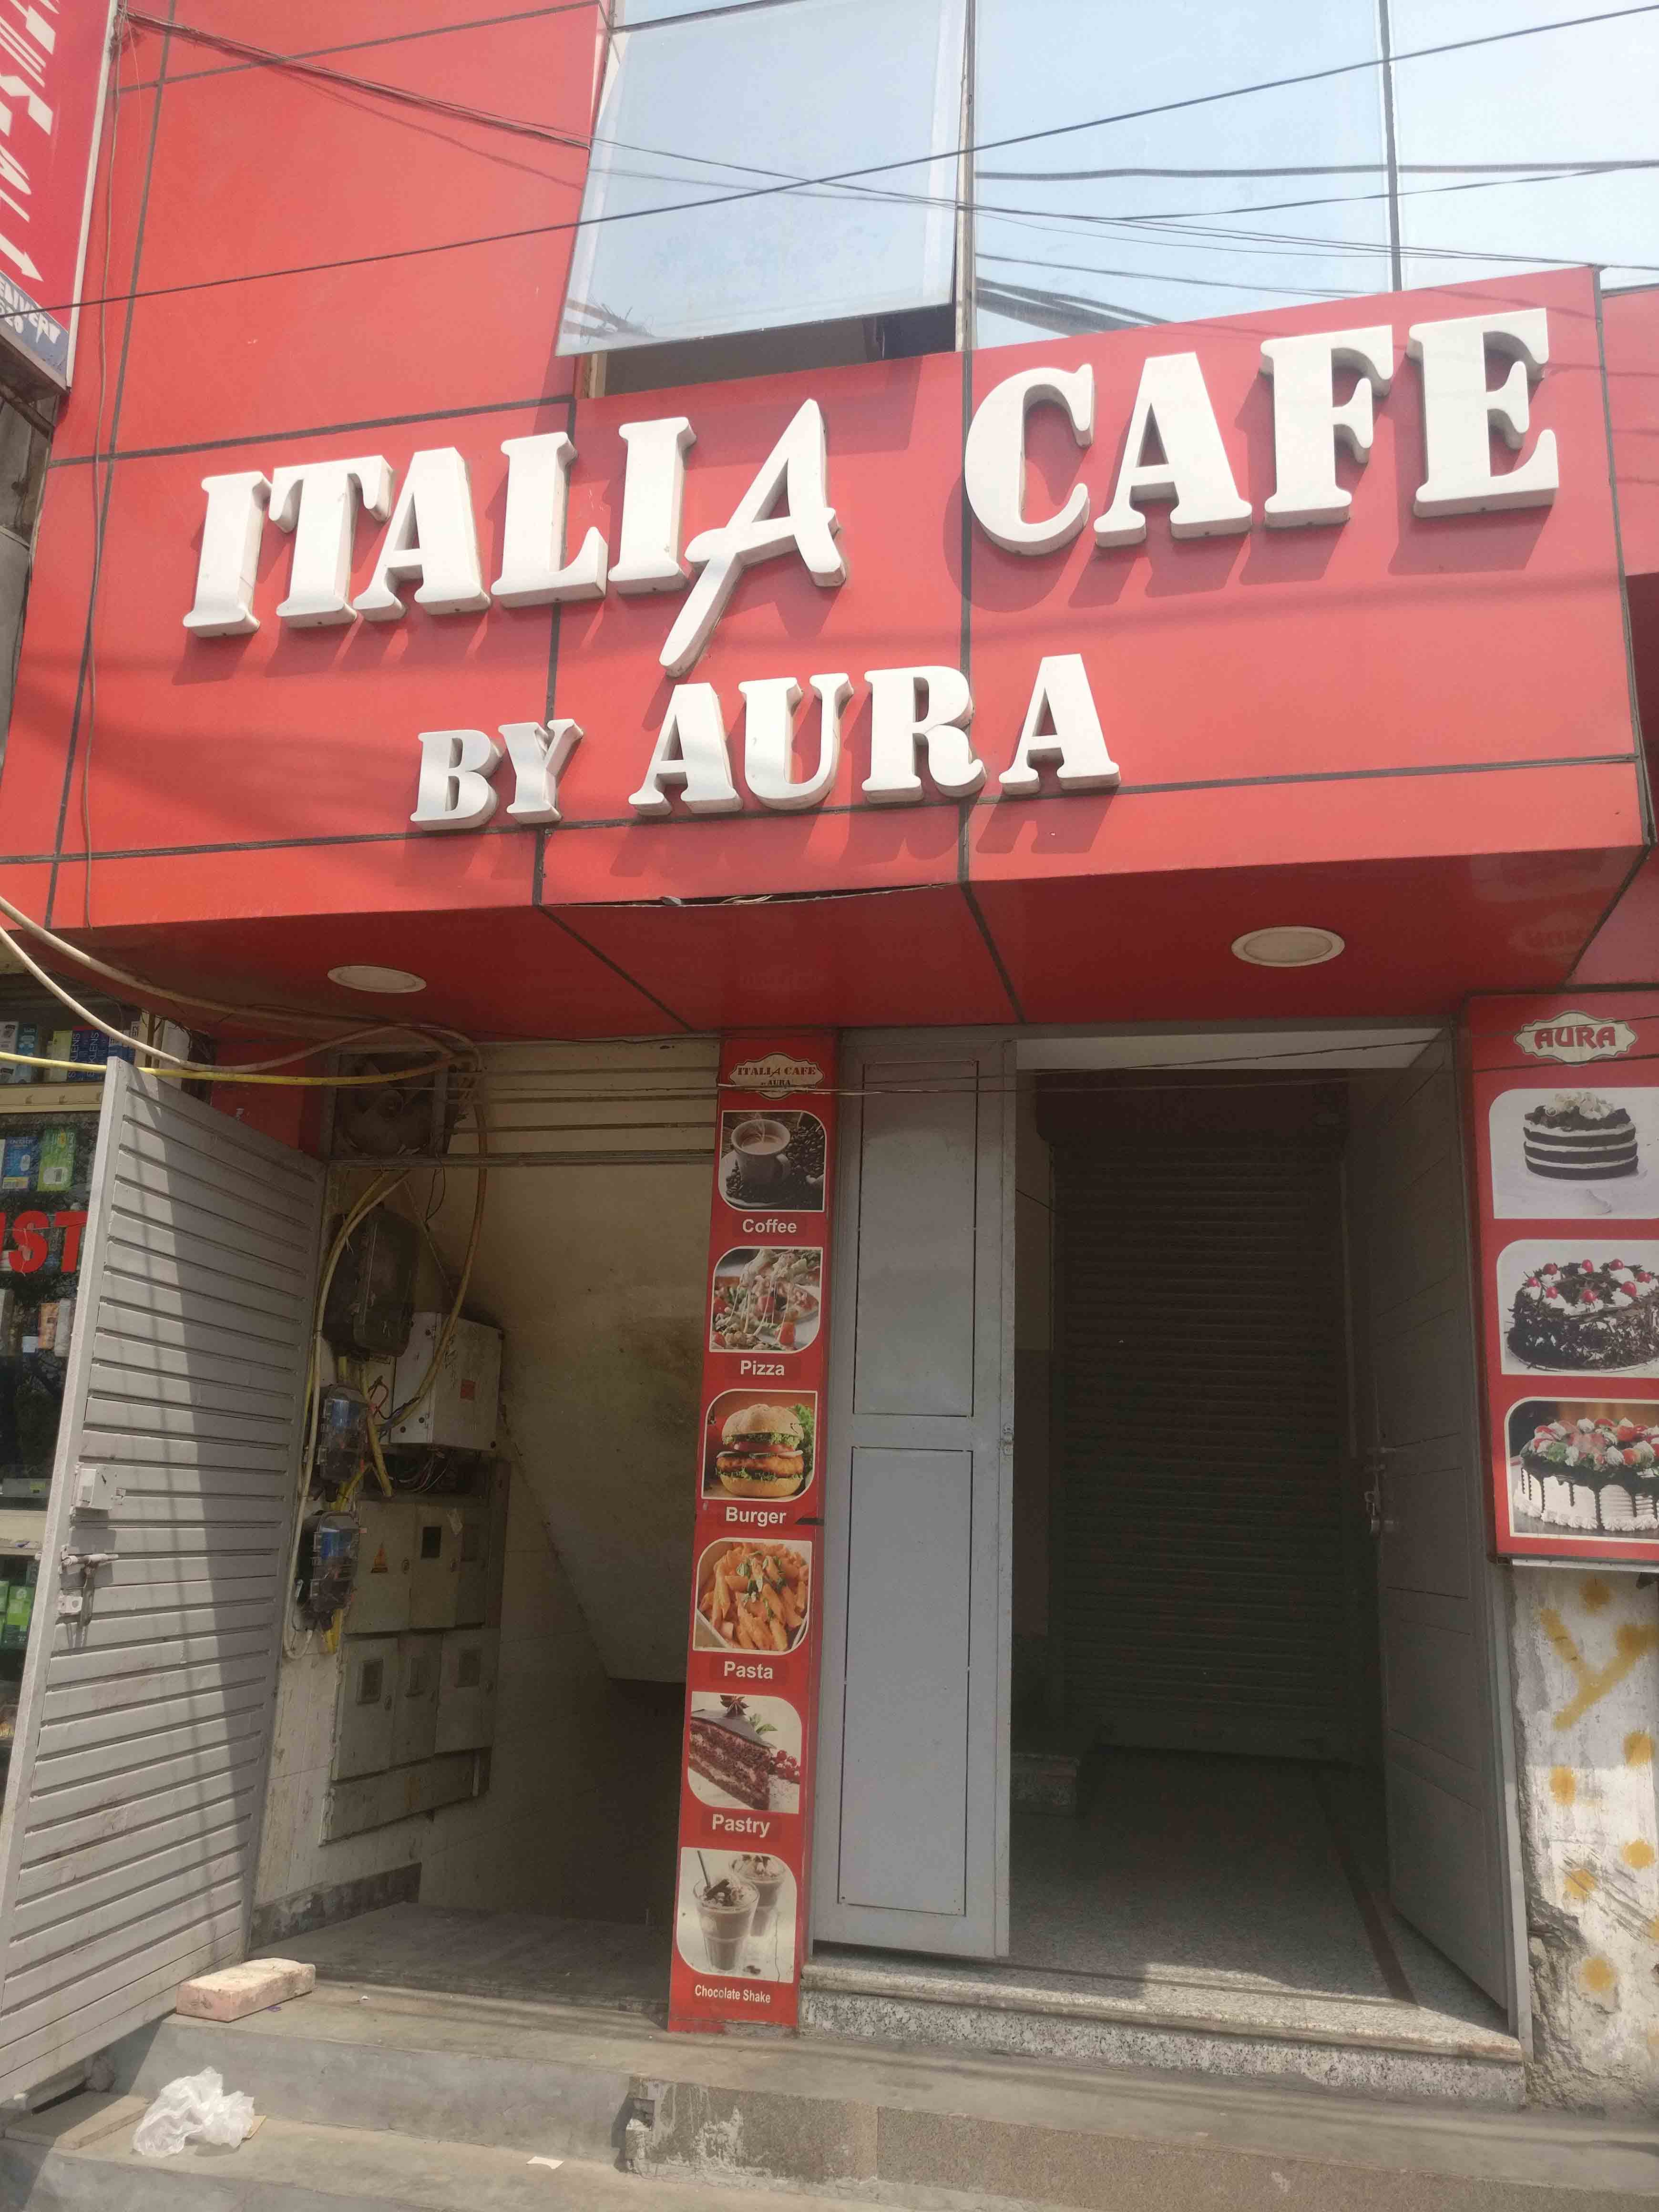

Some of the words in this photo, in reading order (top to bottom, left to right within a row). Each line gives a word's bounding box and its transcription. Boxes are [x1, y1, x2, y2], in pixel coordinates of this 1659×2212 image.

[183, 399, 847, 677] ITALIA
[964, 307, 1560, 557] CAFE
[410, 719, 584, 831] BY
[628, 654, 1120, 810] AURA
[1534, 1025, 1616, 1049] AURA
[738, 1067, 779, 1078] ITALIA
[784, 1067, 816, 1075] CAFE
[742, 1218, 797, 1234] Coffee
[740, 1360, 785, 1376] Pizza
[726, 1506, 786, 1527] Burger
[724, 1661, 773, 1680] Pasta
[712, 1813, 770, 1839] Pastry
[695, 1984, 740, 2000] Chocolate
[743, 1989, 771, 2003] Shake
